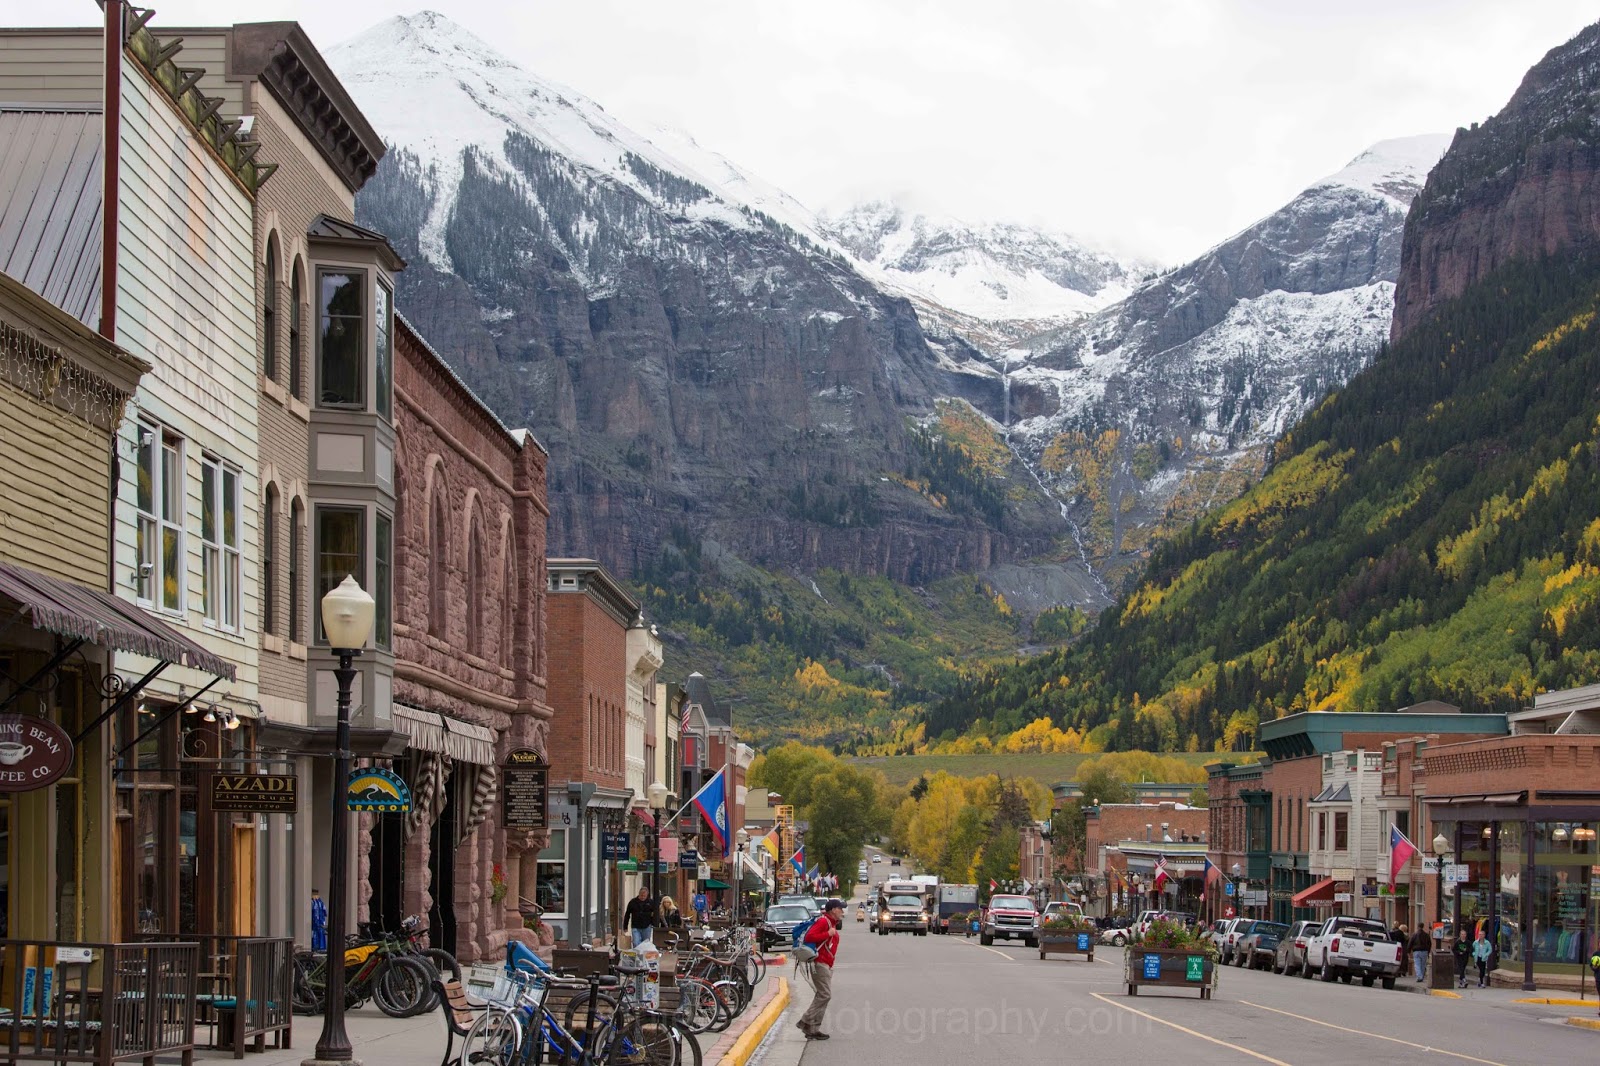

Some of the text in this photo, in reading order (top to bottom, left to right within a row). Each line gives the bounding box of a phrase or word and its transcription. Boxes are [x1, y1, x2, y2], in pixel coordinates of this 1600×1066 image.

[154, 341, 231, 432] SALOON
[0, 724, 61, 754] ING BEAN
[32, 765, 52, 778] CO.
[215, 776, 294, 792] AZADI
[258, 794, 295, 802] Rugs
